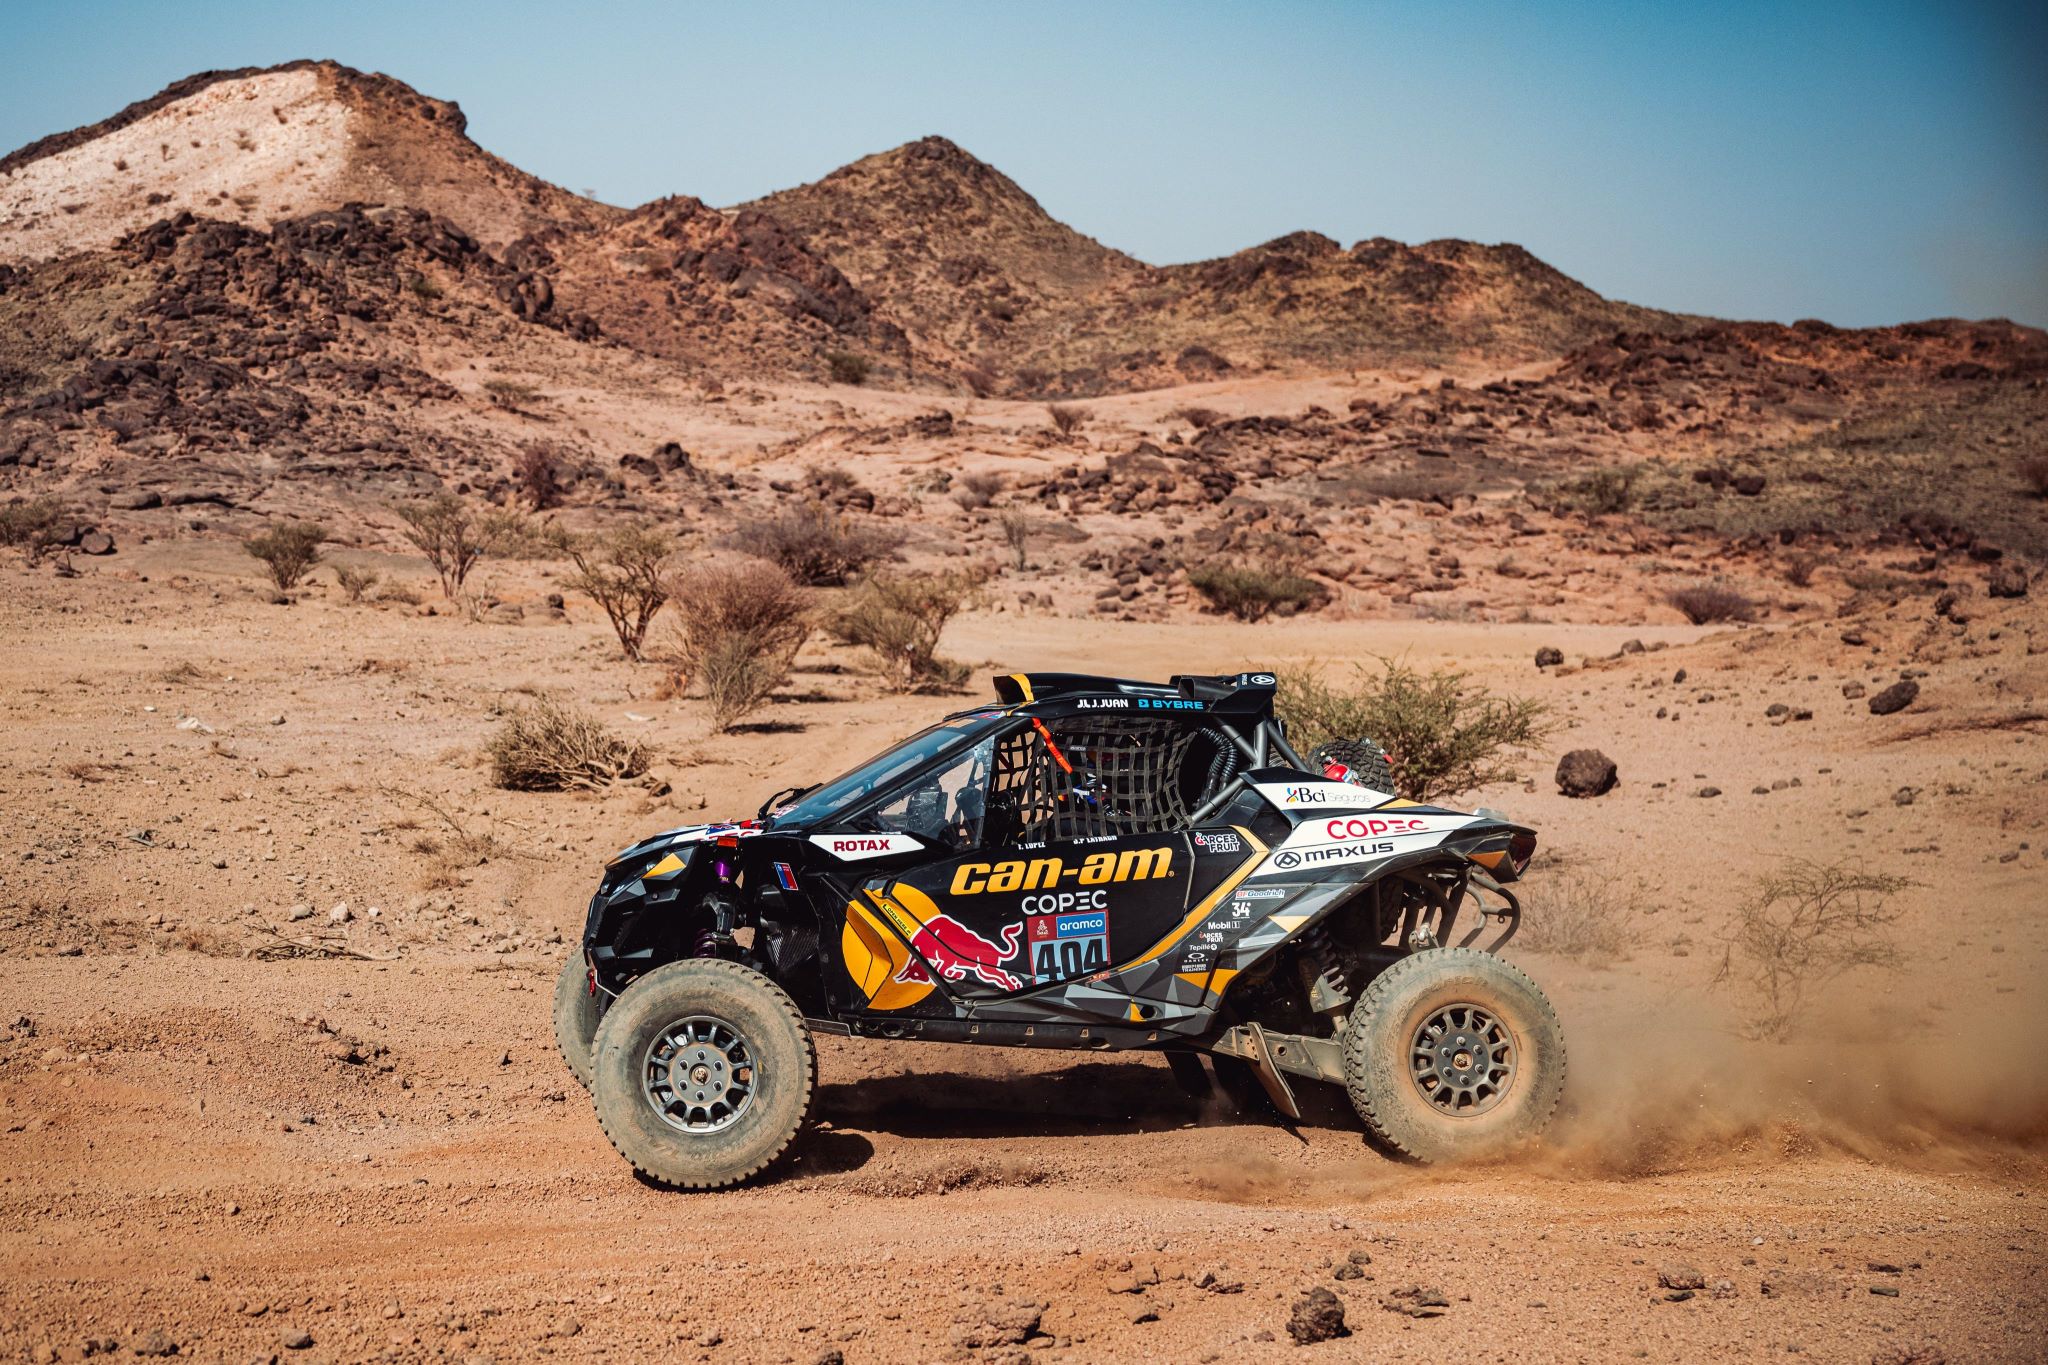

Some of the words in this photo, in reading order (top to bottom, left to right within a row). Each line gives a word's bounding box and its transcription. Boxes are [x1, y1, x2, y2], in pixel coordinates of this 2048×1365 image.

[1152, 701, 1204, 709] BYBRE
[1299, 787, 1326, 803] Bci
[1327, 820, 1429, 840] COPEC
[833, 840, 891, 852] ROTAX
[1209, 841, 1241, 853] FRUIT
[1305, 842, 1394, 863] MAXUS
[950, 847, 1173, 896] can-am
[1021, 889, 1108, 916] COPEC
[1059, 919, 1103, 931] aramco
[1207, 921, 1231, 930] Mobil
[1035, 938, 1107, 982] 404
